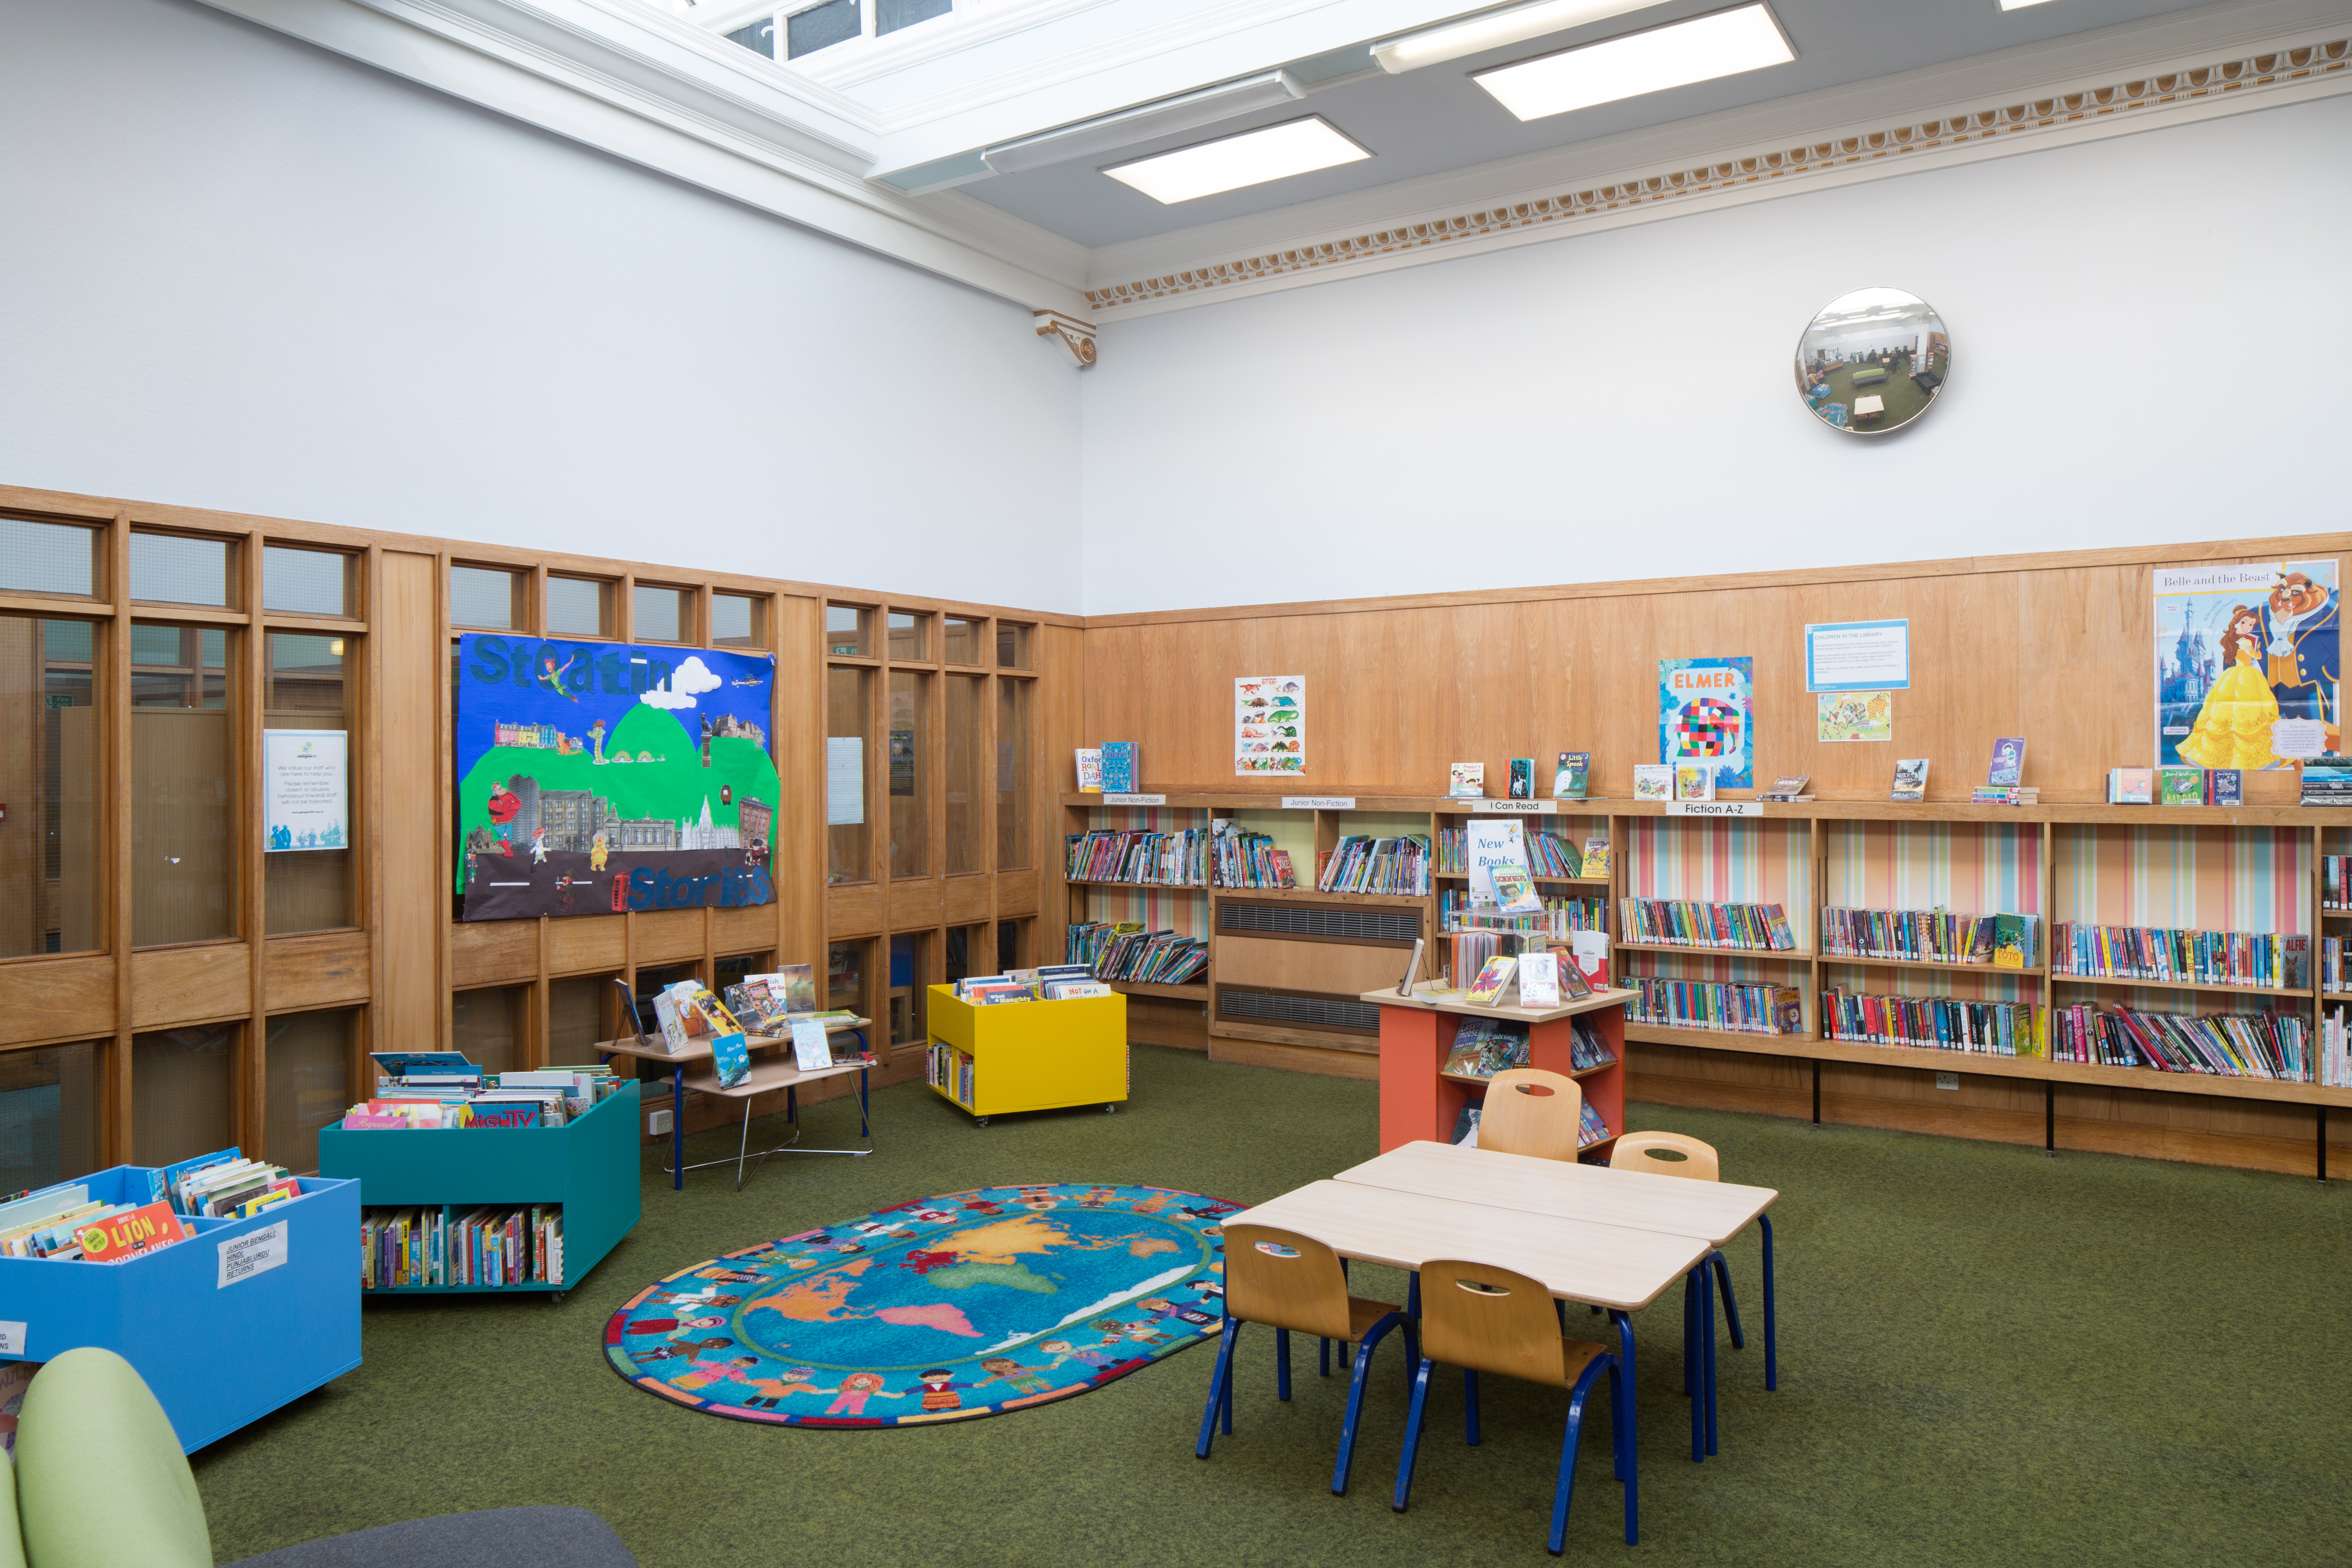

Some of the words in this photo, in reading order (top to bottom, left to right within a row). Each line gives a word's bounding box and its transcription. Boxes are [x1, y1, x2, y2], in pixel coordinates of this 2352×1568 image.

[2164, 577, 2191, 586] Belle
[2194, 575, 2214, 585] and
[2218, 575, 2235, 583] the
[2239, 573, 2270, 582] Beast
[2223, 598, 2236, 608] beauty
[1675, 673, 1735, 688] ELMER
[1991, 771, 2017, 783] NORM
[2167, 793, 2181, 803] BAD
[1686, 804, 1722, 813] Fiction
[1725, 805, 1743, 814] A-Z
[1477, 839, 1504, 849] New
[1277, 859, 1291, 870] JOKES
[1478, 856, 1515, 866] Books
[628, 866, 771, 910] Stories
[2285, 939, 2306, 951] ALFIE
[1998, 950, 2019, 961] TOTO
[1526, 982, 1552, 991] Kick
[1461, 1023, 1481, 1031] LASER
[1458, 1029, 1479, 1040] MOOSE
[355, 1117, 400, 1129] Rapunzel
[111, 1216, 157, 1248] LION
[227, 1241, 248, 1252] JUNIOR
[227, 1263, 254, 1278] RETURNS
